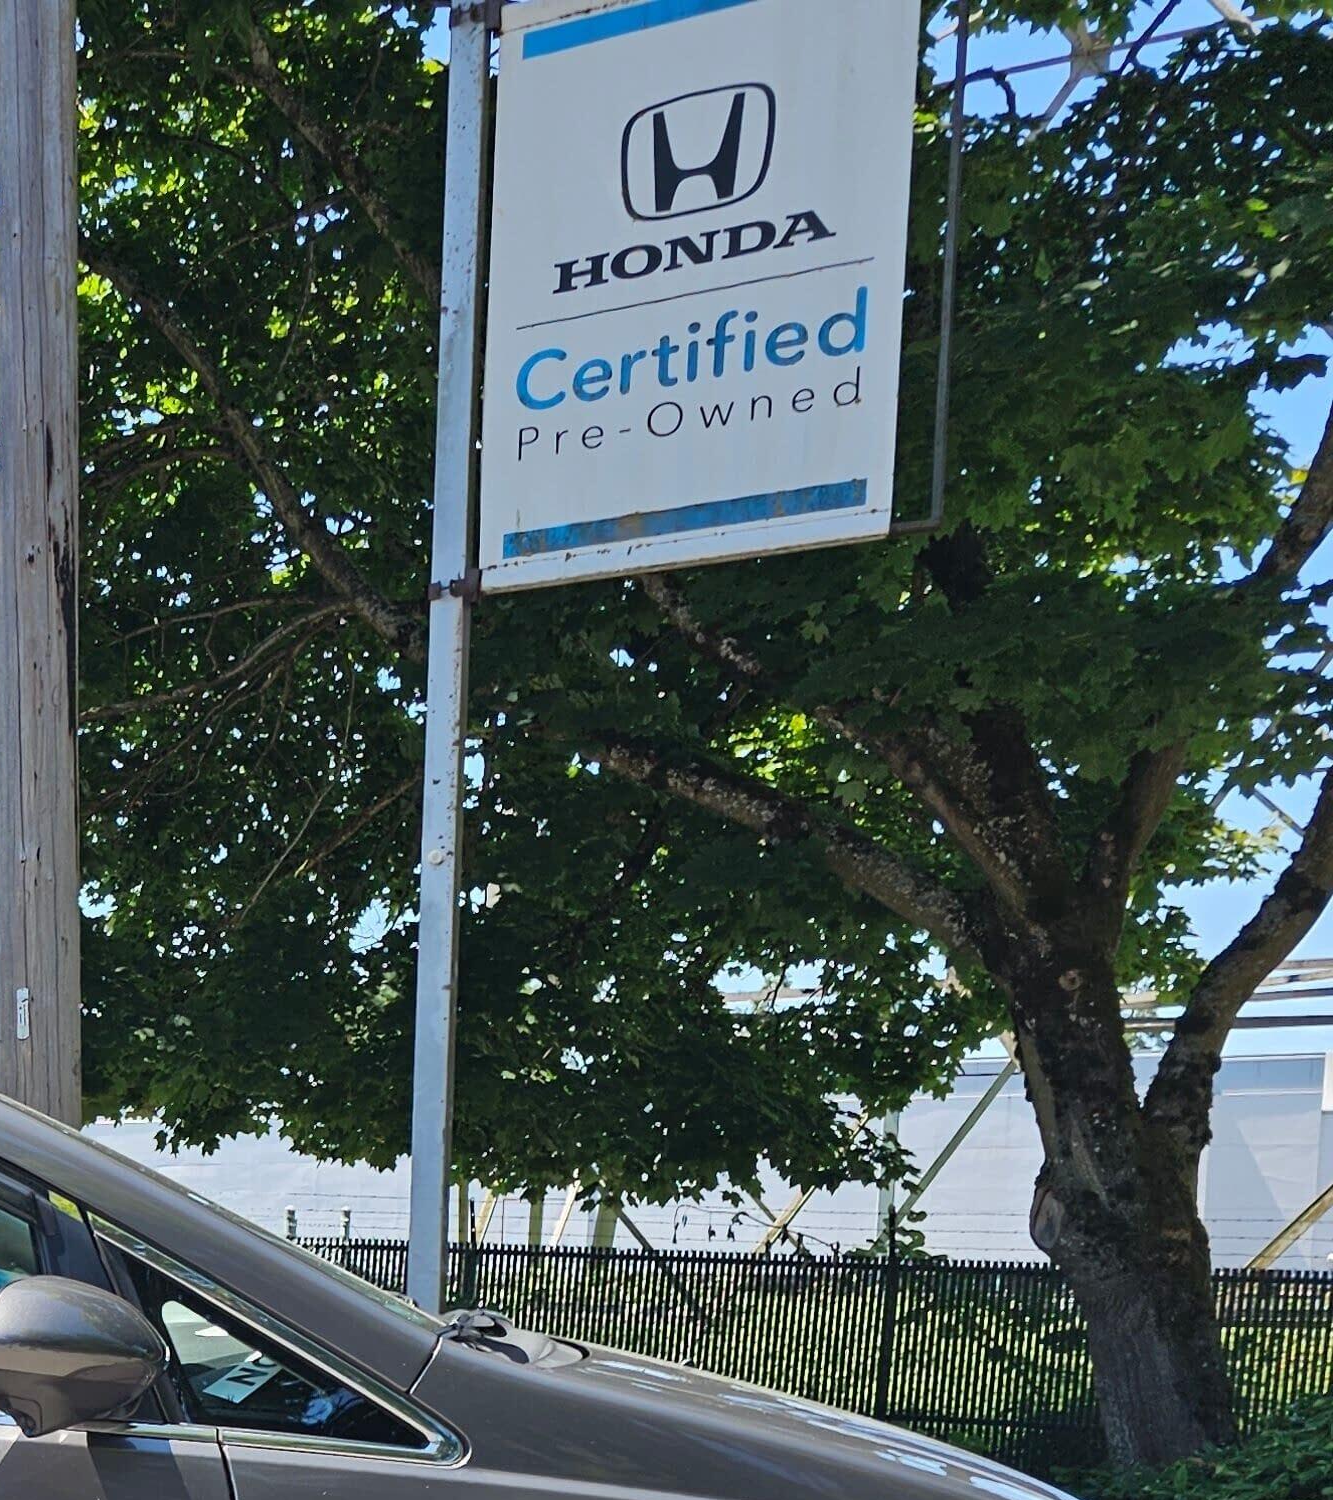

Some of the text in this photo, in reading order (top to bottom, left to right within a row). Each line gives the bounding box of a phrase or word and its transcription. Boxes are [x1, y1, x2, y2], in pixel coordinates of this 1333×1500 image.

[552, 210, 837, 294] HONDA
[515, 286, 869, 410] Certified
[517, 366, 861, 462] Pre-Owned
